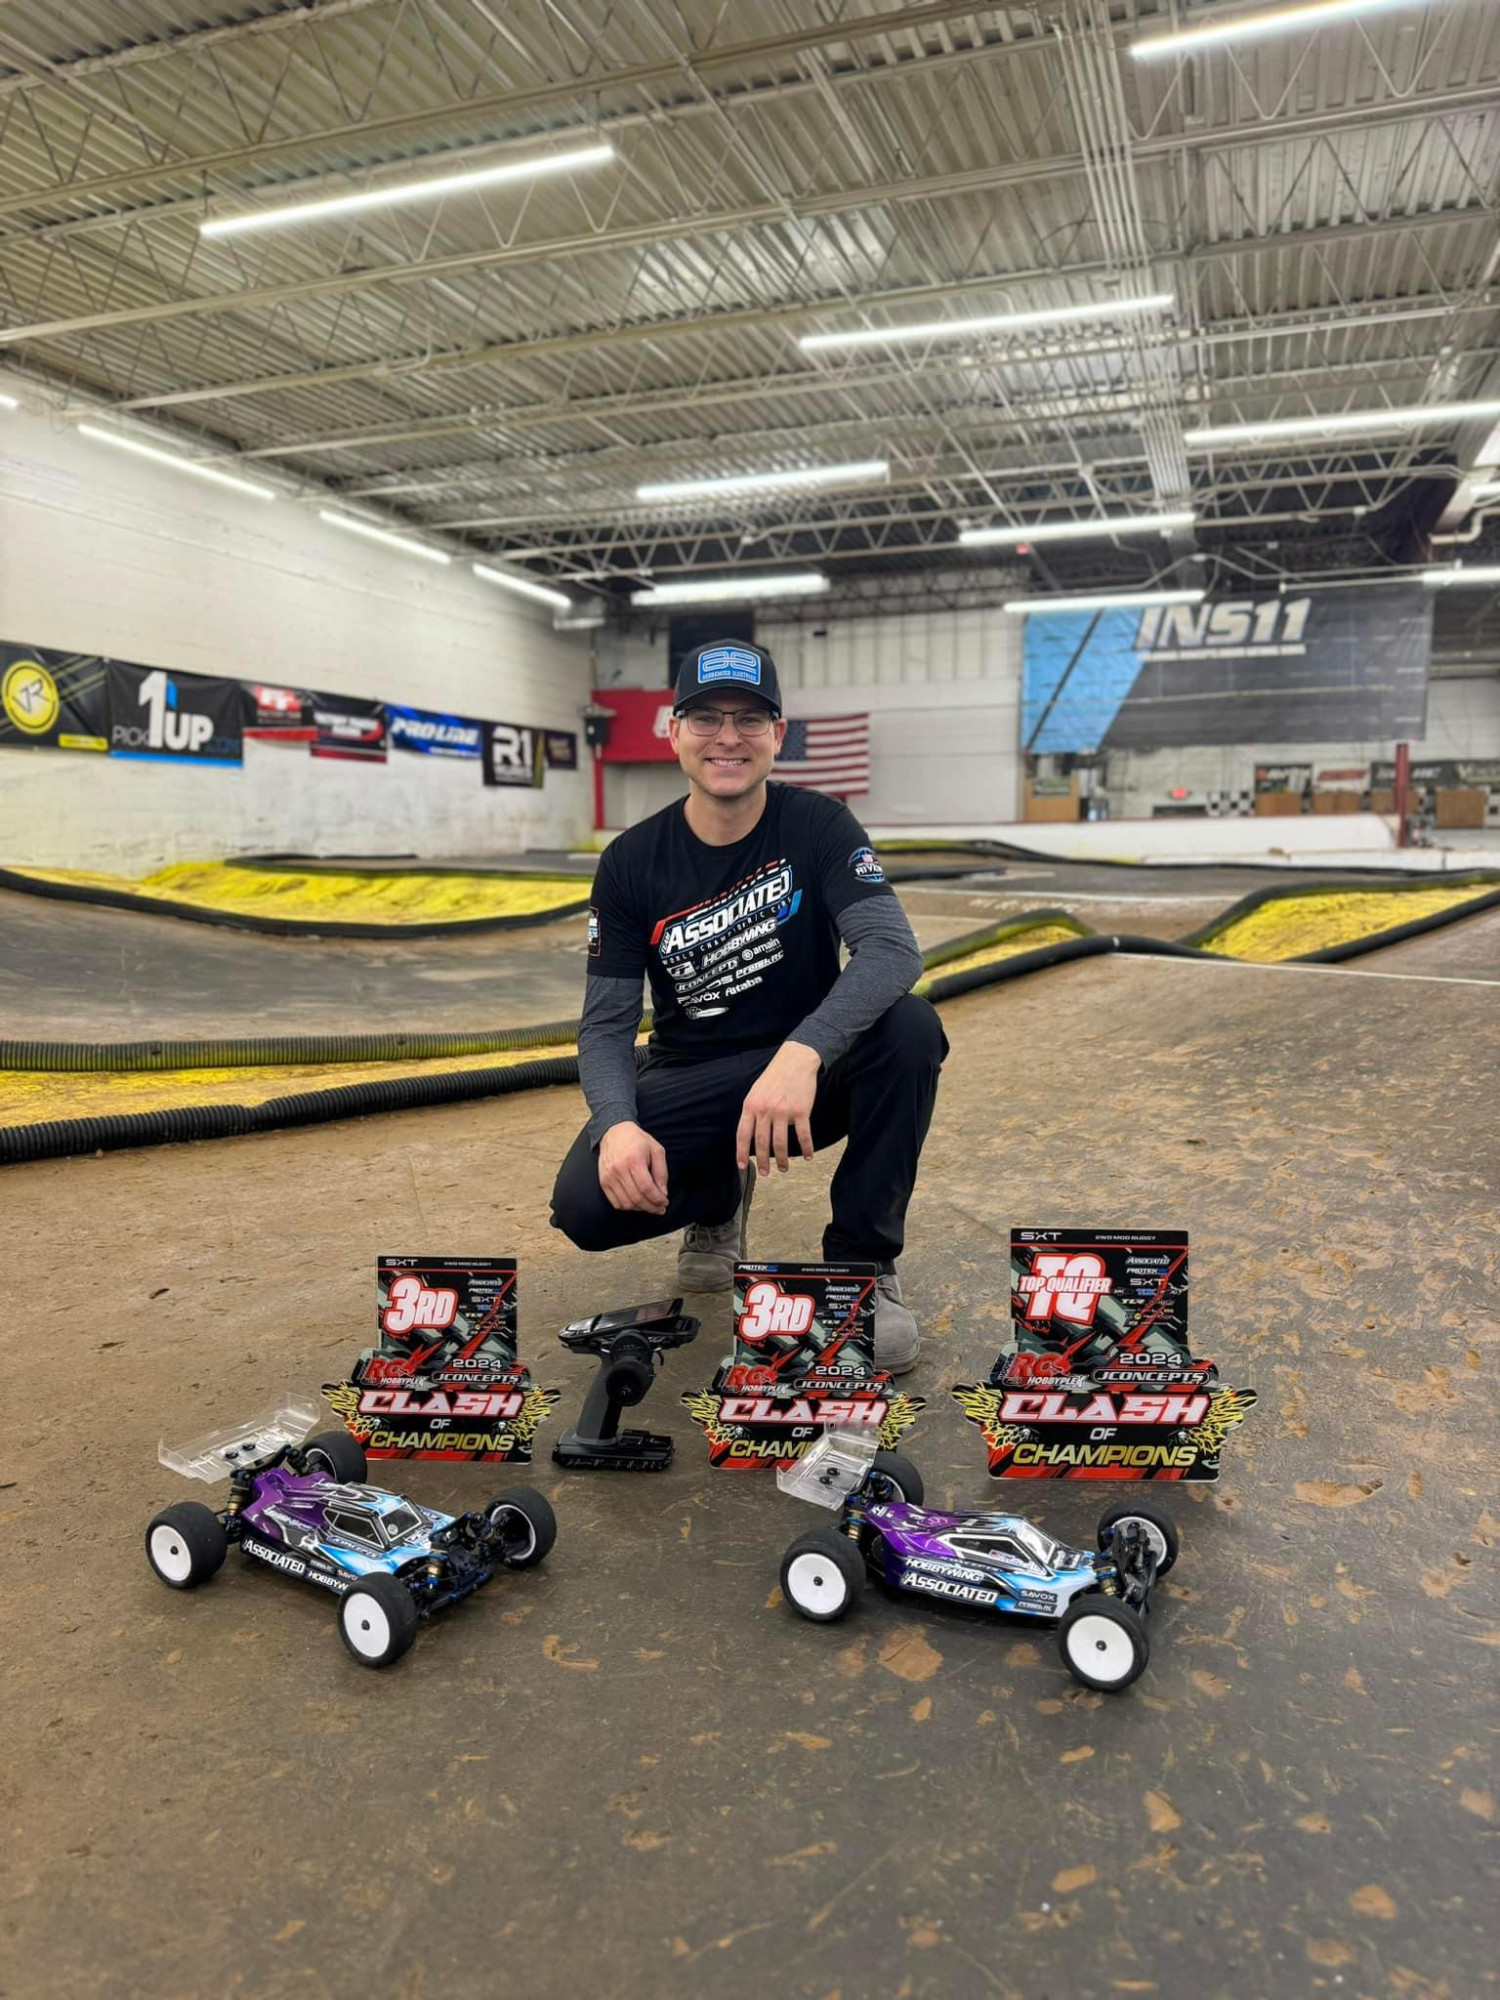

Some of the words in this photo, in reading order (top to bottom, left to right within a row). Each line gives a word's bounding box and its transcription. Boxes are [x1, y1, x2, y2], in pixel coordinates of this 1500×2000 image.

[492, 726, 533, 767] R1
[666, 870, 790, 953] ASSOCIATED
[1020, 1231, 1062, 1241] SXT
[385, 1258, 418, 1266] SXT
[1020, 1275, 1045, 1293] TOP
[1046, 1275, 1112, 1294] QUALIFIER
[386, 1277, 457, 1332] 3RD
[743, 1284, 812, 1337] 3RD
[452, 1358, 502, 1369] 2024
[1119, 1352, 1183, 1365] 2024
[436, 1373, 519, 1384] JCONCEPTS
[815, 1366, 866, 1376] 2024
[1098, 1371, 1205, 1384] JCONCEPTS
[798, 1380, 884, 1391] JCONCEPTS
[1028, 1375, 1089, 1388] HOBBYPLEX
[359, 1391, 525, 1417] CLASH
[719, 1398, 887, 1424] CLASH
[1001, 1393, 1210, 1424] CLASH
[429, 1418, 452, 1429] OF
[791, 1426, 814, 1437] OF
[370, 1431, 516, 1451] CHAMPIONS
[1090, 1427, 1117, 1440] OF
[1013, 1444, 1199, 1466] CHAMPIONS
[244, 1540, 306, 1574] ASSOCIATED
[906, 1558, 984, 1582] HOBBYWING
[905, 1572, 999, 1604] ASSOCIATED
